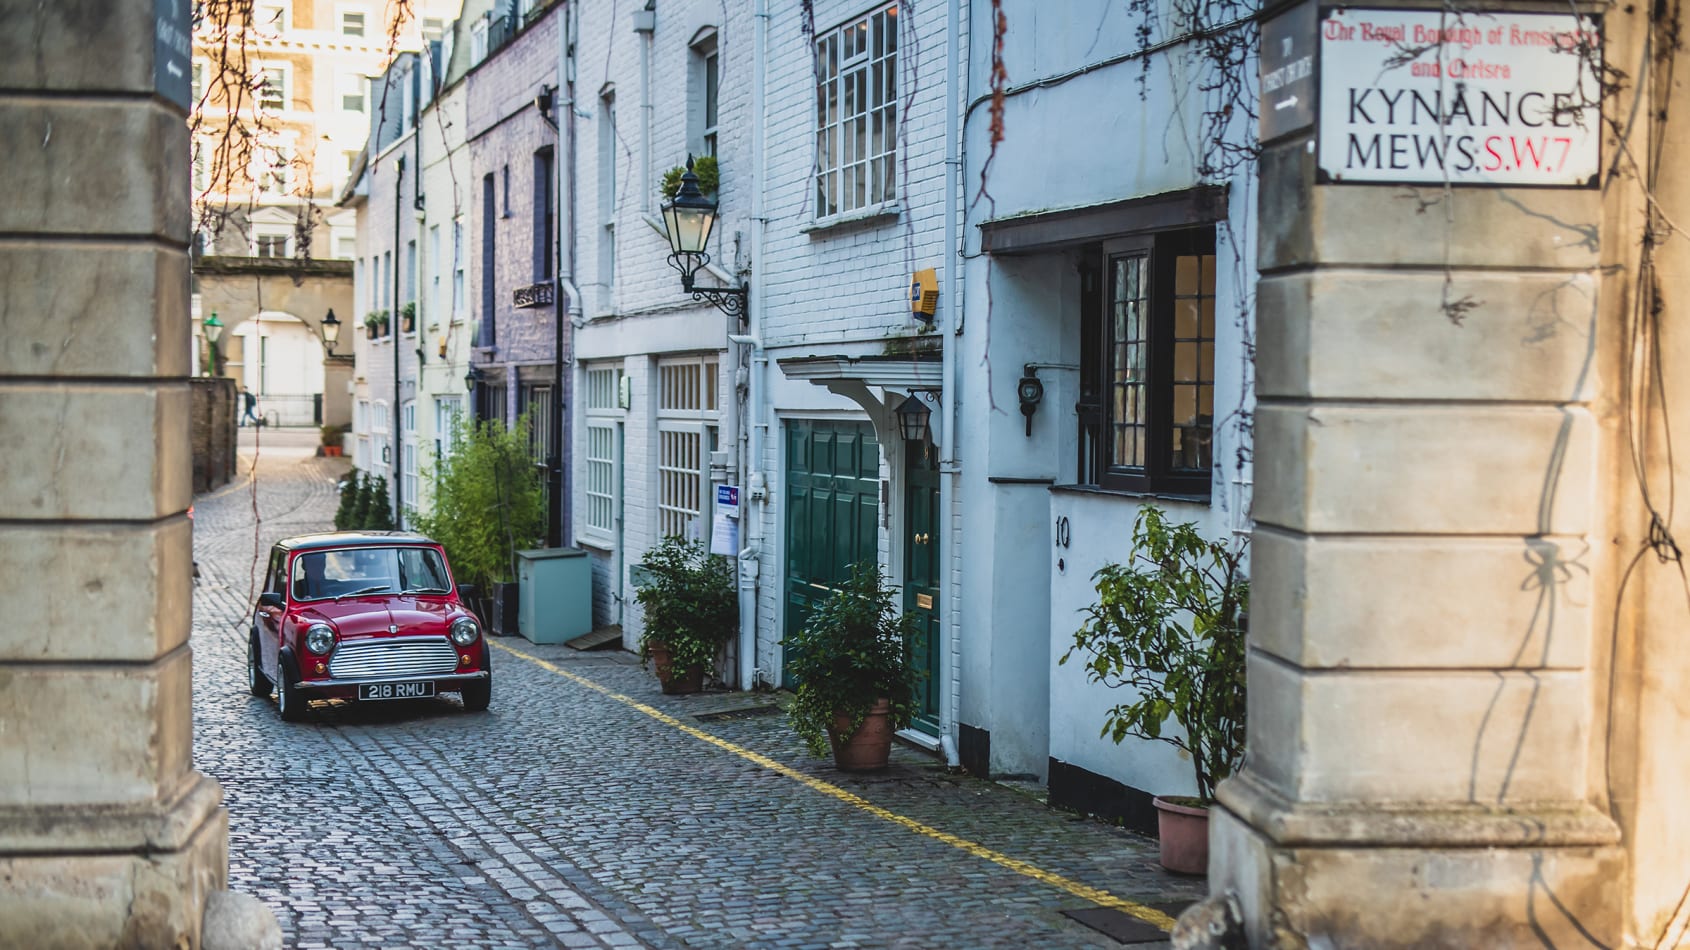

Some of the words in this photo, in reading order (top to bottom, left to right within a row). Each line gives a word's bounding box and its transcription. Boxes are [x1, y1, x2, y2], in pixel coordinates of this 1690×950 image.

[1324, 19, 1355, 41] The
[1360, 22, 1405, 47] Royal
[1487, 27, 1503, 45] of
[1411, 61, 1440, 78] and
[1447, 58, 1511, 79] Chelsea
[1348, 88, 1574, 127] KYNANCE
[1056, 515, 1070, 549] 10
[368, 684, 392, 698] 218
[395, 683, 425, 697] RMU
